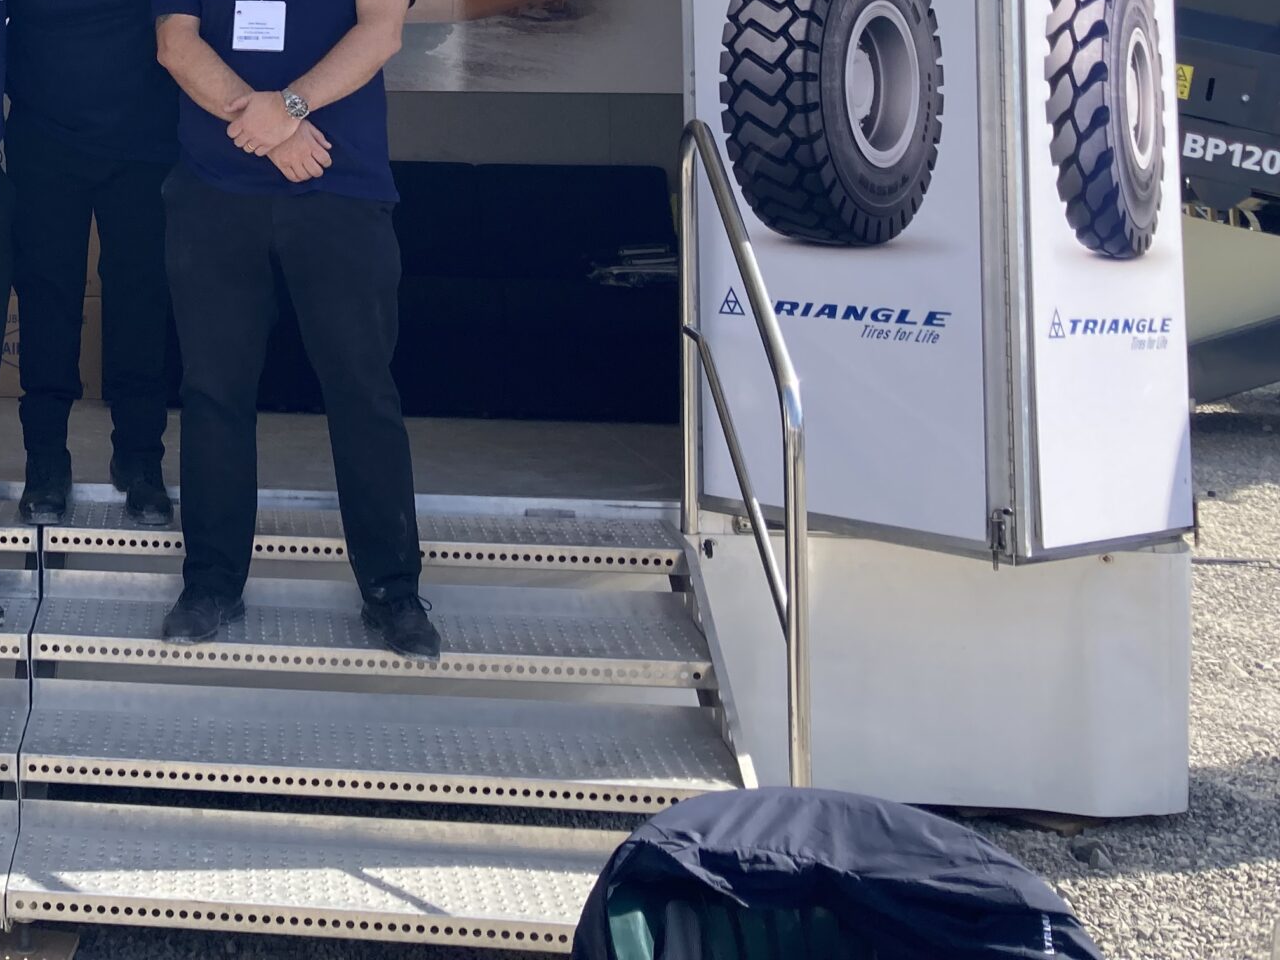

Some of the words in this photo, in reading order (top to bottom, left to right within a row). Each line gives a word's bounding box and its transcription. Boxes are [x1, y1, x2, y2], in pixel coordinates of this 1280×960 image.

[1182, 132, 1280, 175] BP120
[771, 300, 952, 328] RIANGLE
[1069, 317, 1172, 335] TRIANGLE
[861, 324, 891, 340] Tires
[893, 327, 913, 341] for
[914, 328, 940, 344] Life
